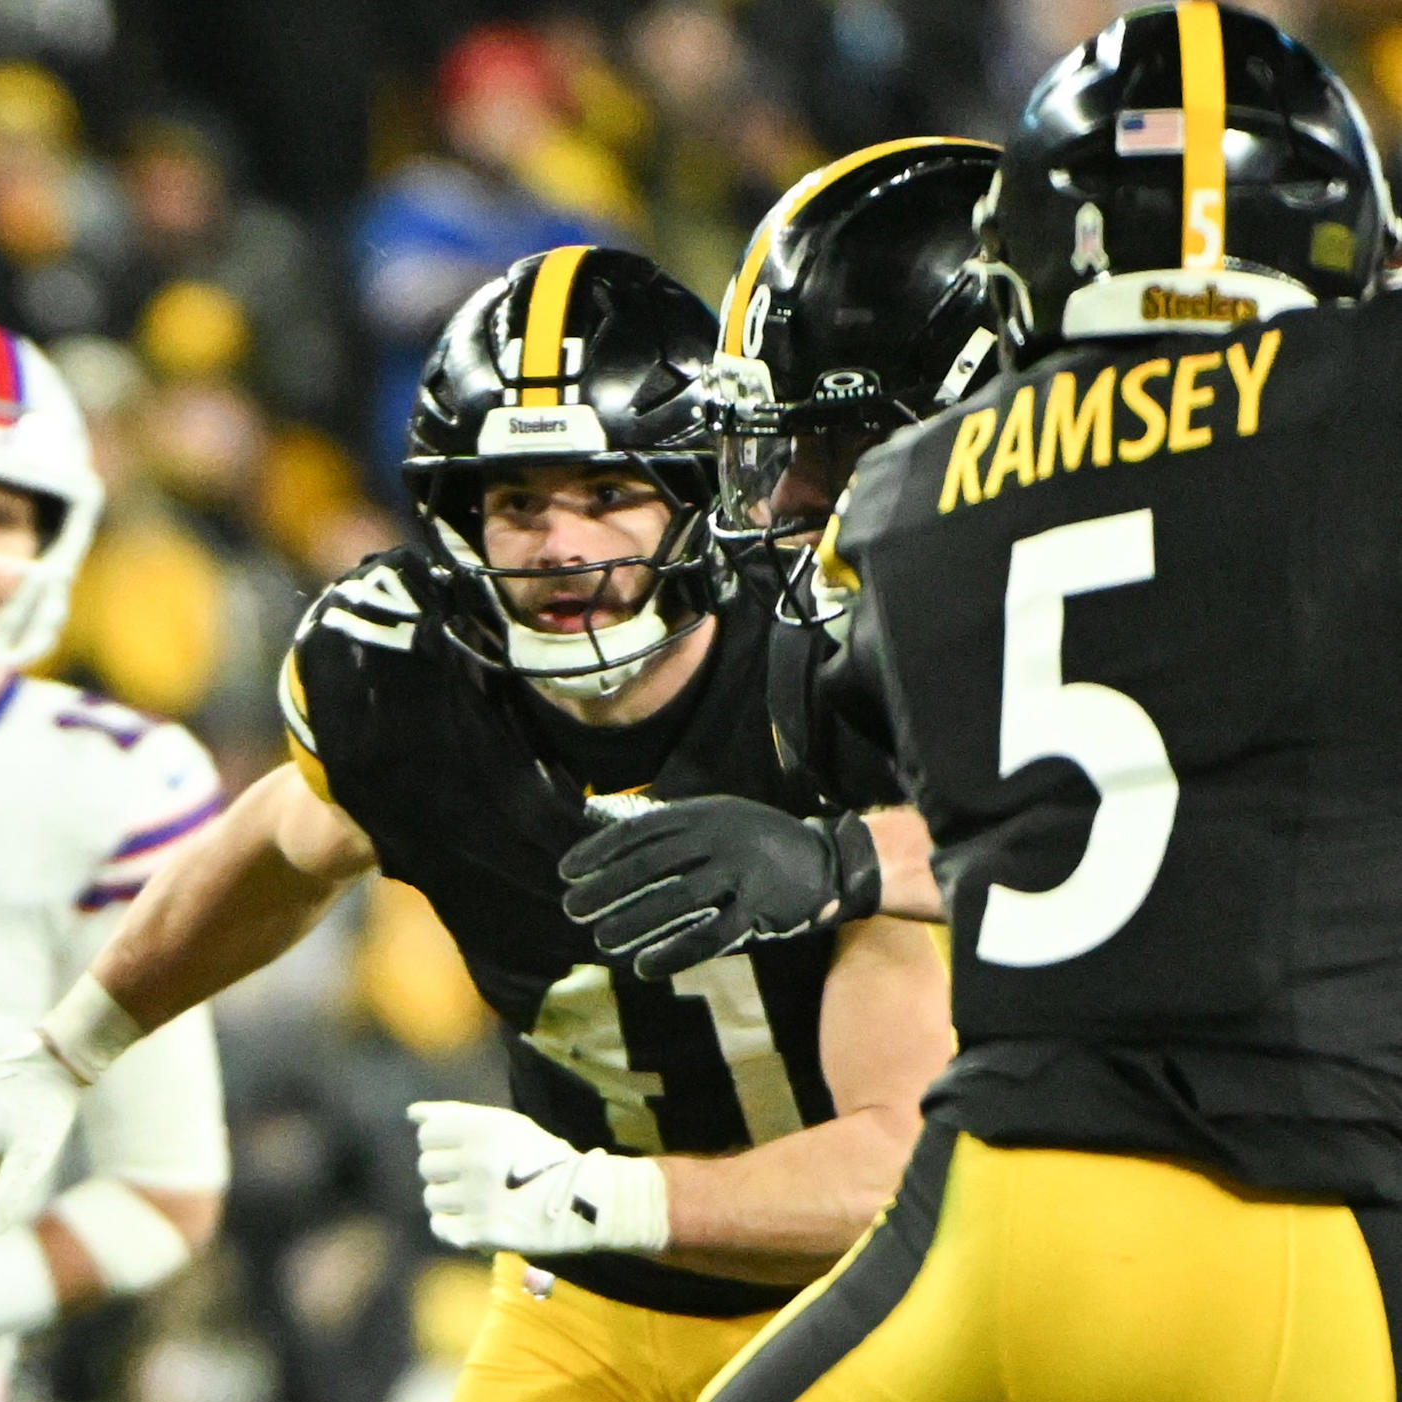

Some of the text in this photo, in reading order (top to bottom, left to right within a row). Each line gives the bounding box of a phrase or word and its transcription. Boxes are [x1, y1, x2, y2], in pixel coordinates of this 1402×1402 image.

[1184, 187, 1224, 269] 5
[509, 415, 568, 434] Steelers
[939, 329, 1283, 515] RAMSEY
[977, 508, 1180, 968] 5
[519, 952, 805, 1152] 41
